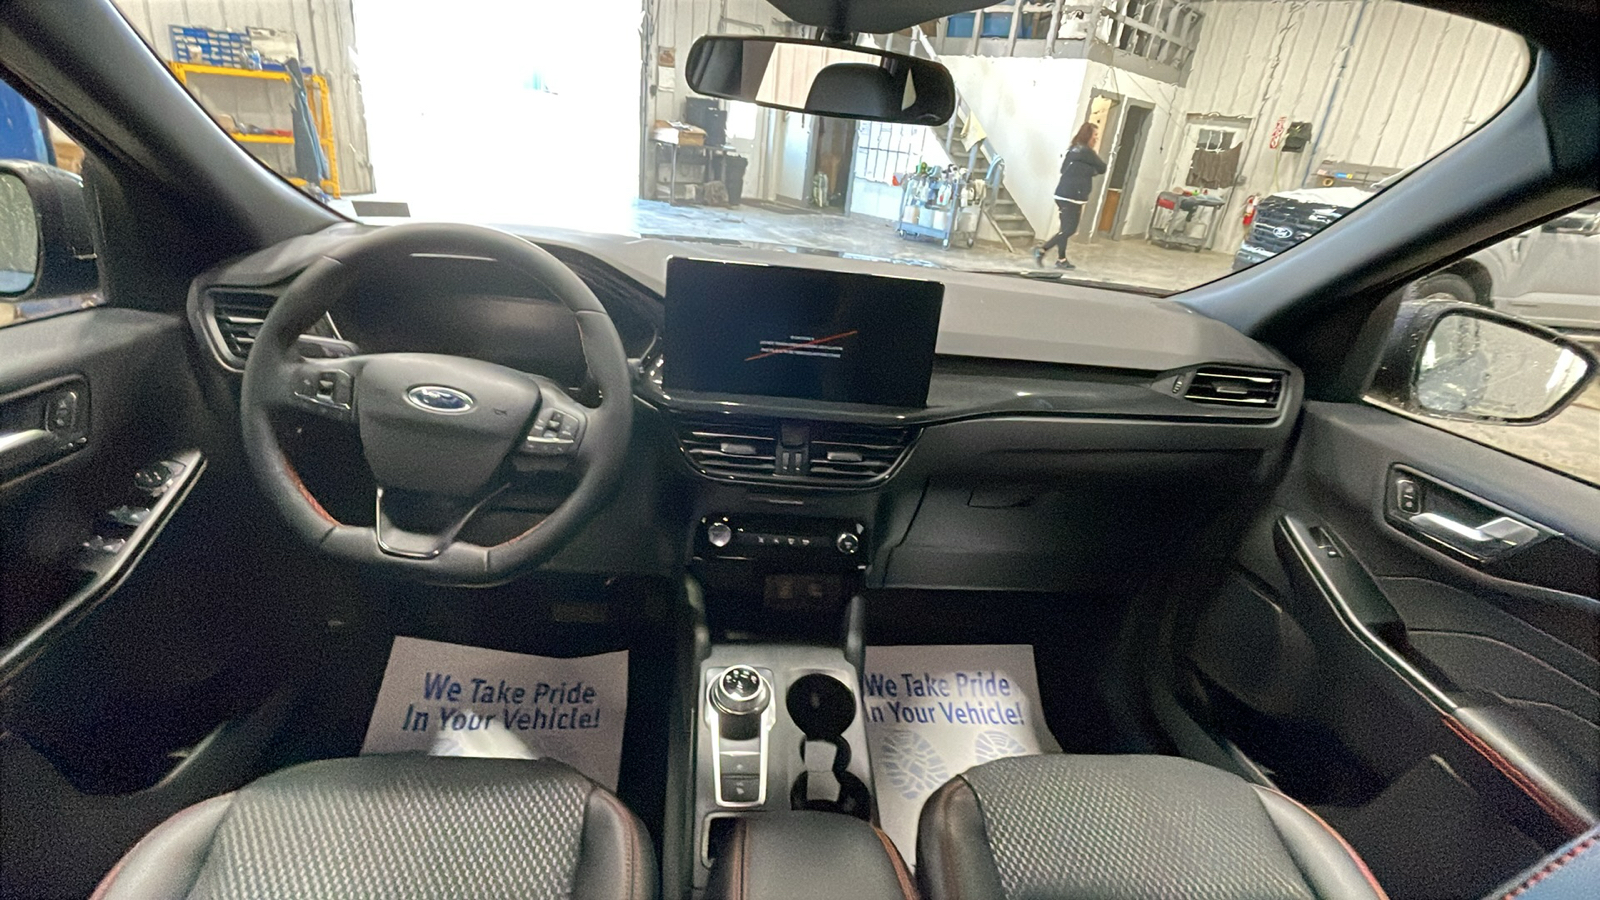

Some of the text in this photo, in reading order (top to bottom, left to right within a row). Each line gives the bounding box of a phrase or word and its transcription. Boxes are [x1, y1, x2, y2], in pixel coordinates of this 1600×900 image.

[424, 672, 597, 704] We Take Pride
[864, 671, 1011, 698] We Take Pride
[402, 703, 600, 732] In Your Vehicle!
[887, 701, 936, 723] Your
[938, 701, 1025, 726] Vehicle!
